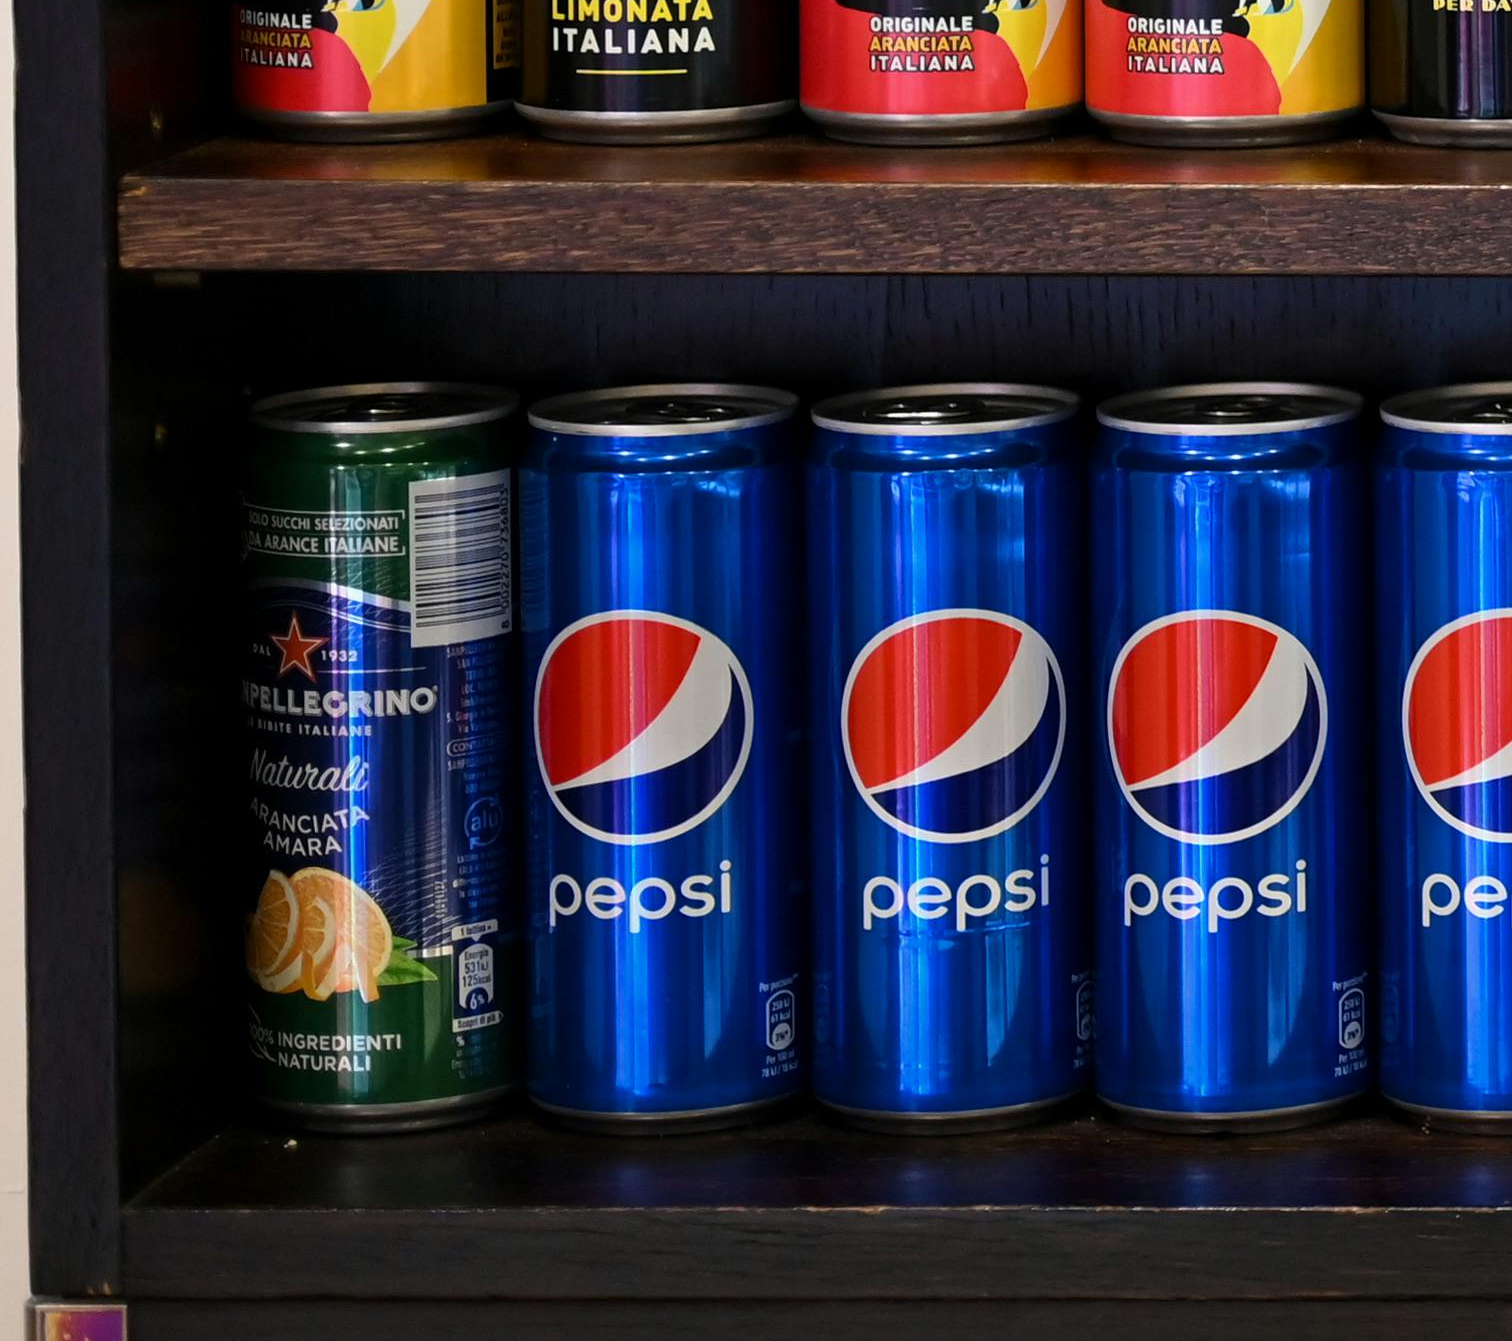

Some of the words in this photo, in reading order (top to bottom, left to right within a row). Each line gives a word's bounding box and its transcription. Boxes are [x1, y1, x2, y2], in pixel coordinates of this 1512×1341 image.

[870, 15, 973, 35] ORIGINALE
[552, 26, 715, 53] ITALIANA
[869, 35, 973, 53] ARANCIATA
[870, 54, 974, 73] ITALIANA
[549, 859, 732, 934] pepsi
[862, 854, 1050, 932] pepsi
[1124, 859, 1308, 933] pepsi
